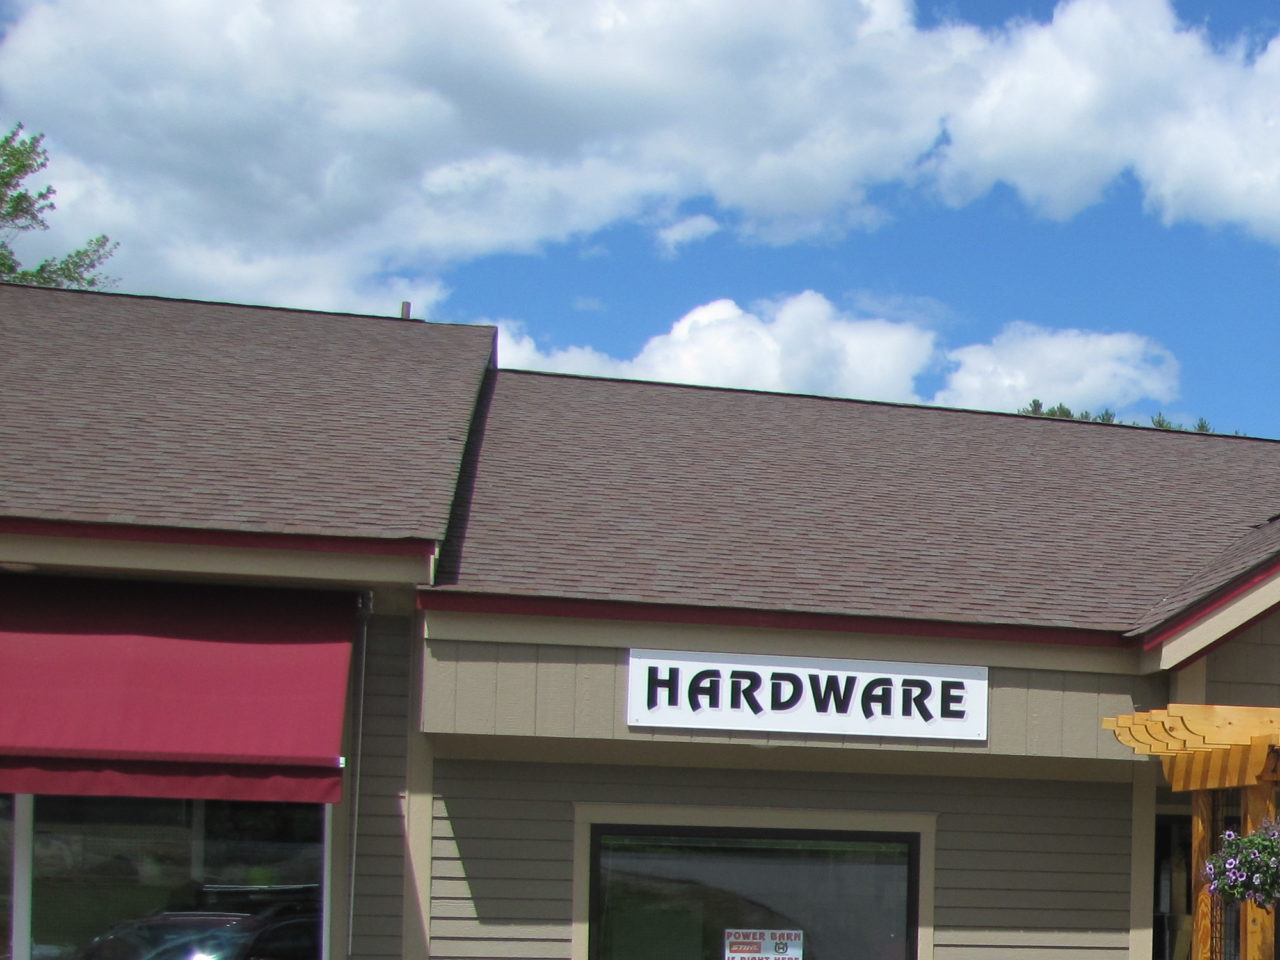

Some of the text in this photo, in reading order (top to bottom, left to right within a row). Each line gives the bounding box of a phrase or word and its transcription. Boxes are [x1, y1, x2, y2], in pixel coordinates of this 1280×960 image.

[646, 665, 968, 724] HARDWARE
[726, 931, 801, 942] POWER BARN
